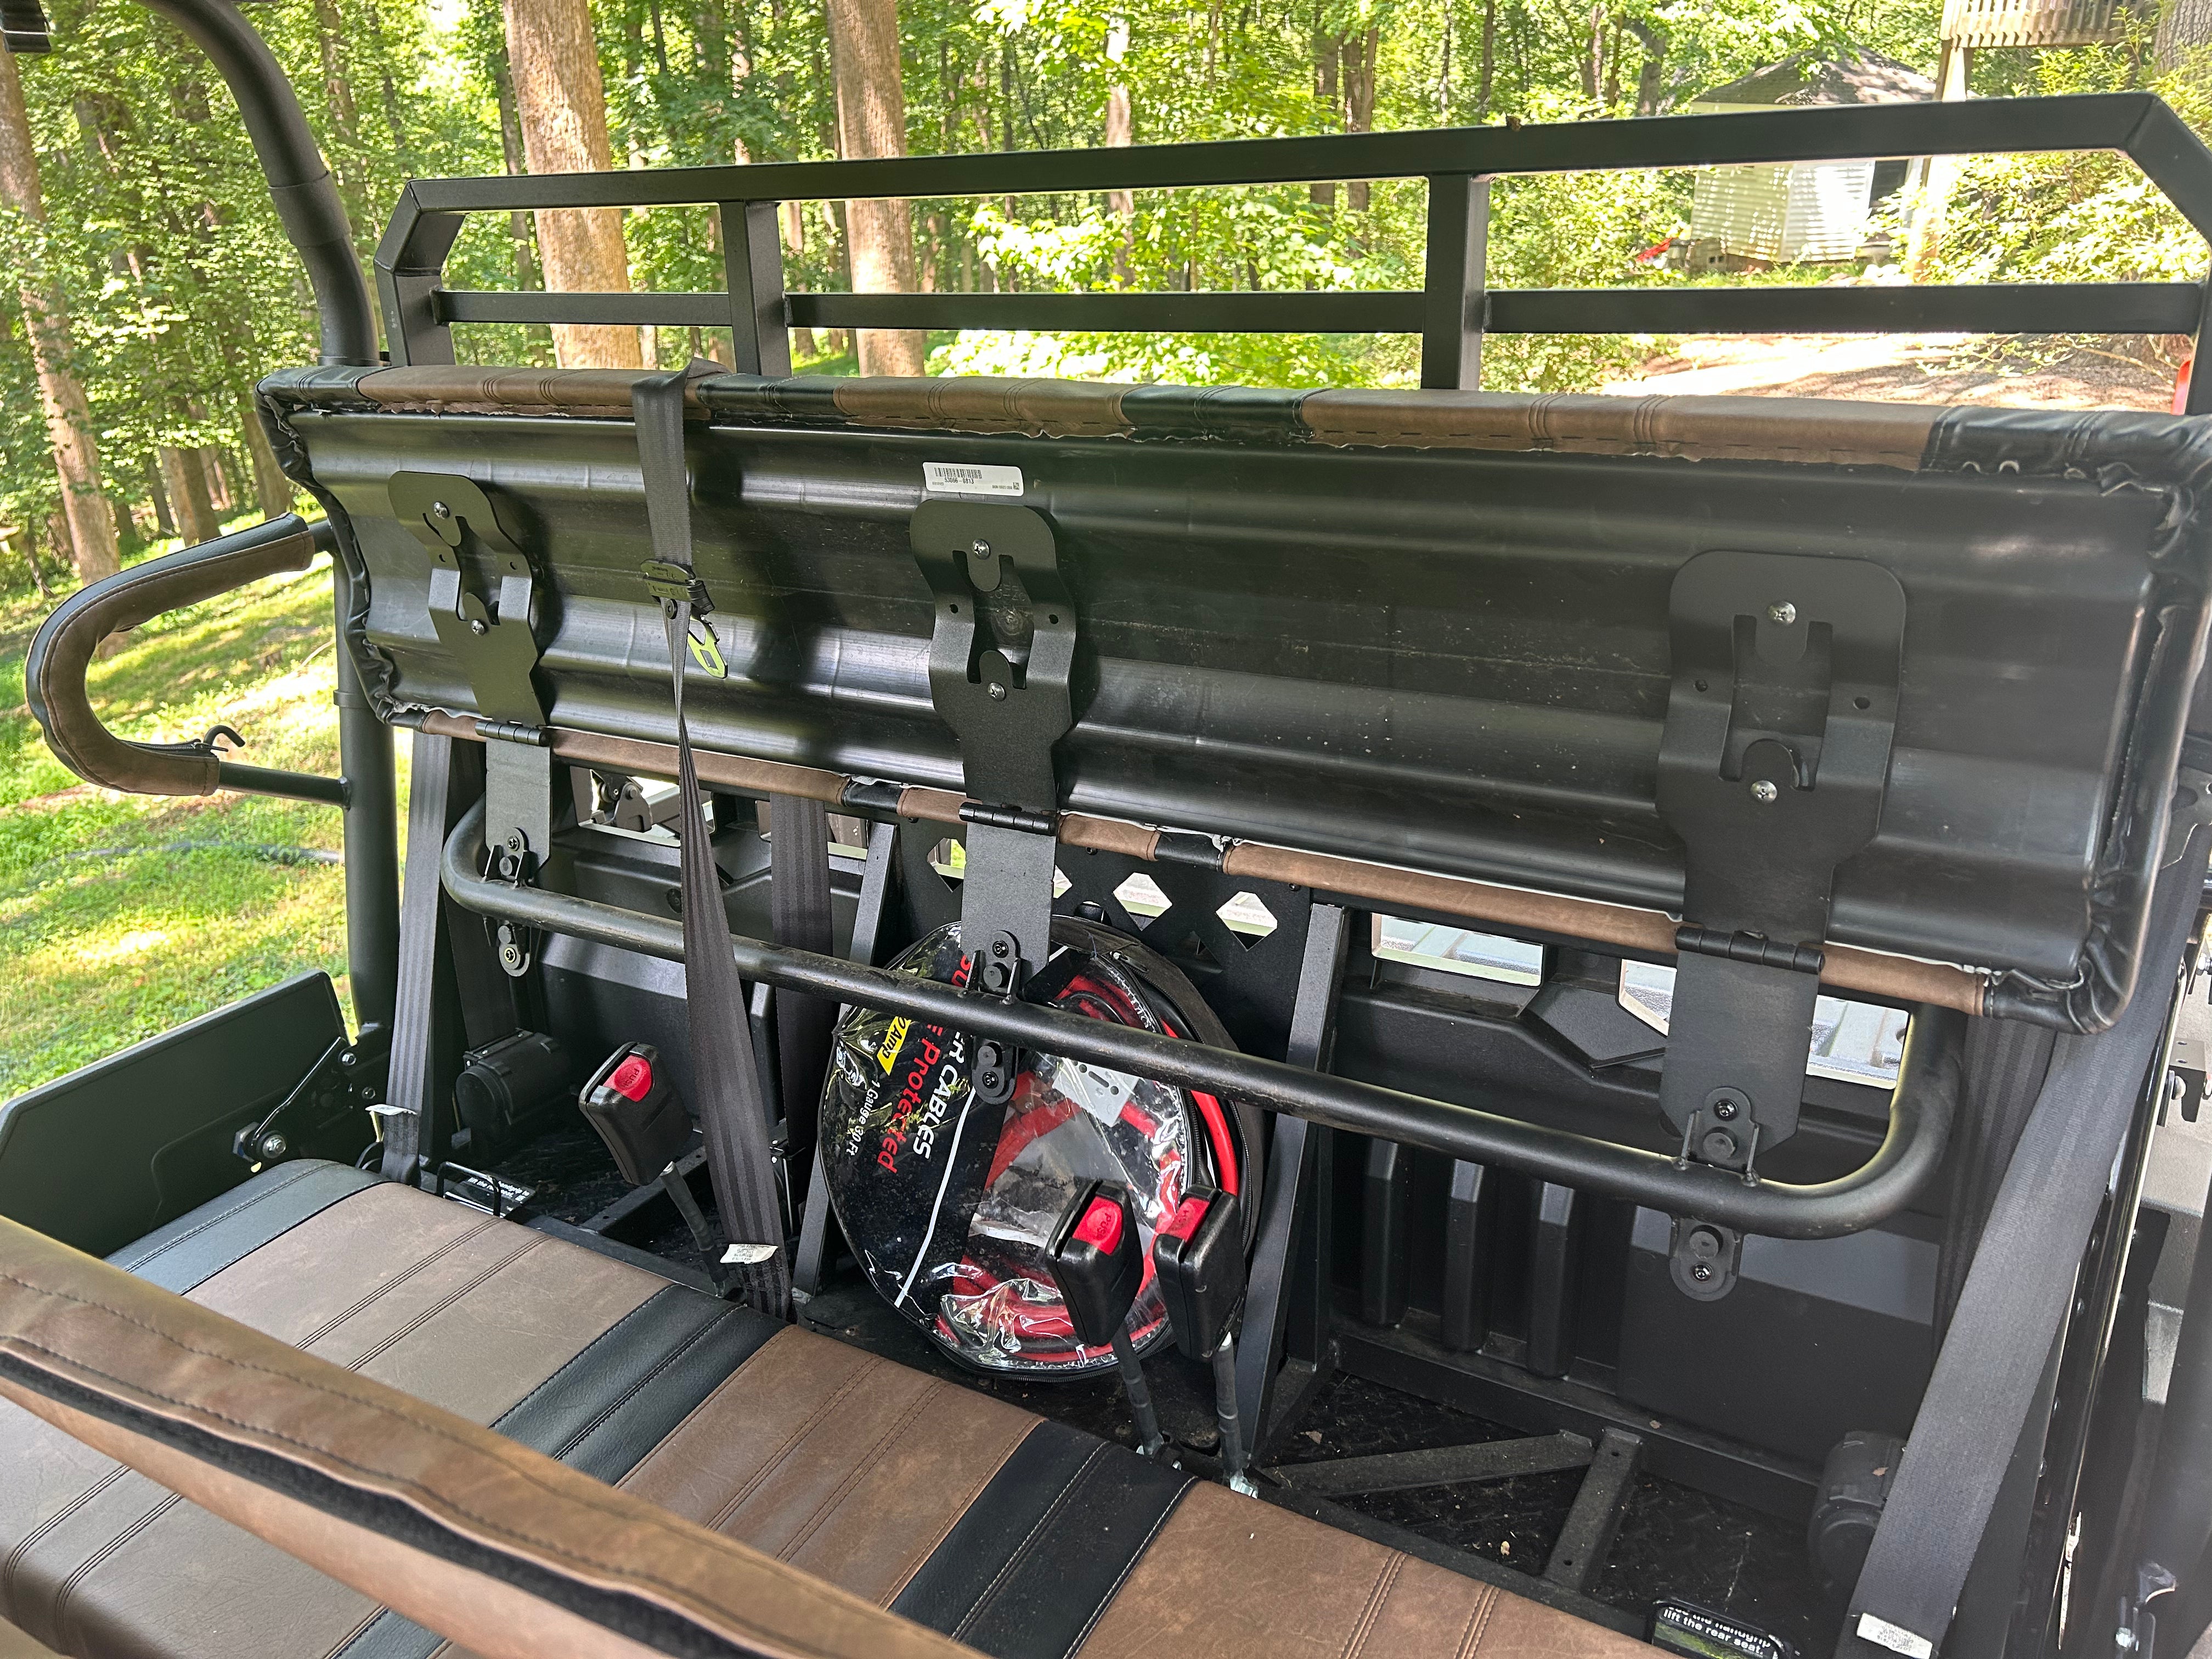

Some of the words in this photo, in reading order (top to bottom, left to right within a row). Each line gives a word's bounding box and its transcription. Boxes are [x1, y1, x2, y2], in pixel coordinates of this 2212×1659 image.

[859, 1088, 879, 1125] Gauge
[877, 1037, 941, 1173] Protected
[913, 1064, 958, 1159] CABLES
[846, 1142, 859, 1156] Ft
[852, 1125, 864, 1142] 30
[1663, 1609, 1680, 1622] lift
[1683, 1617, 1703, 1631] the
[1705, 1627, 1731, 1642] rear
[1733, 1638, 1764, 1655] seat.
